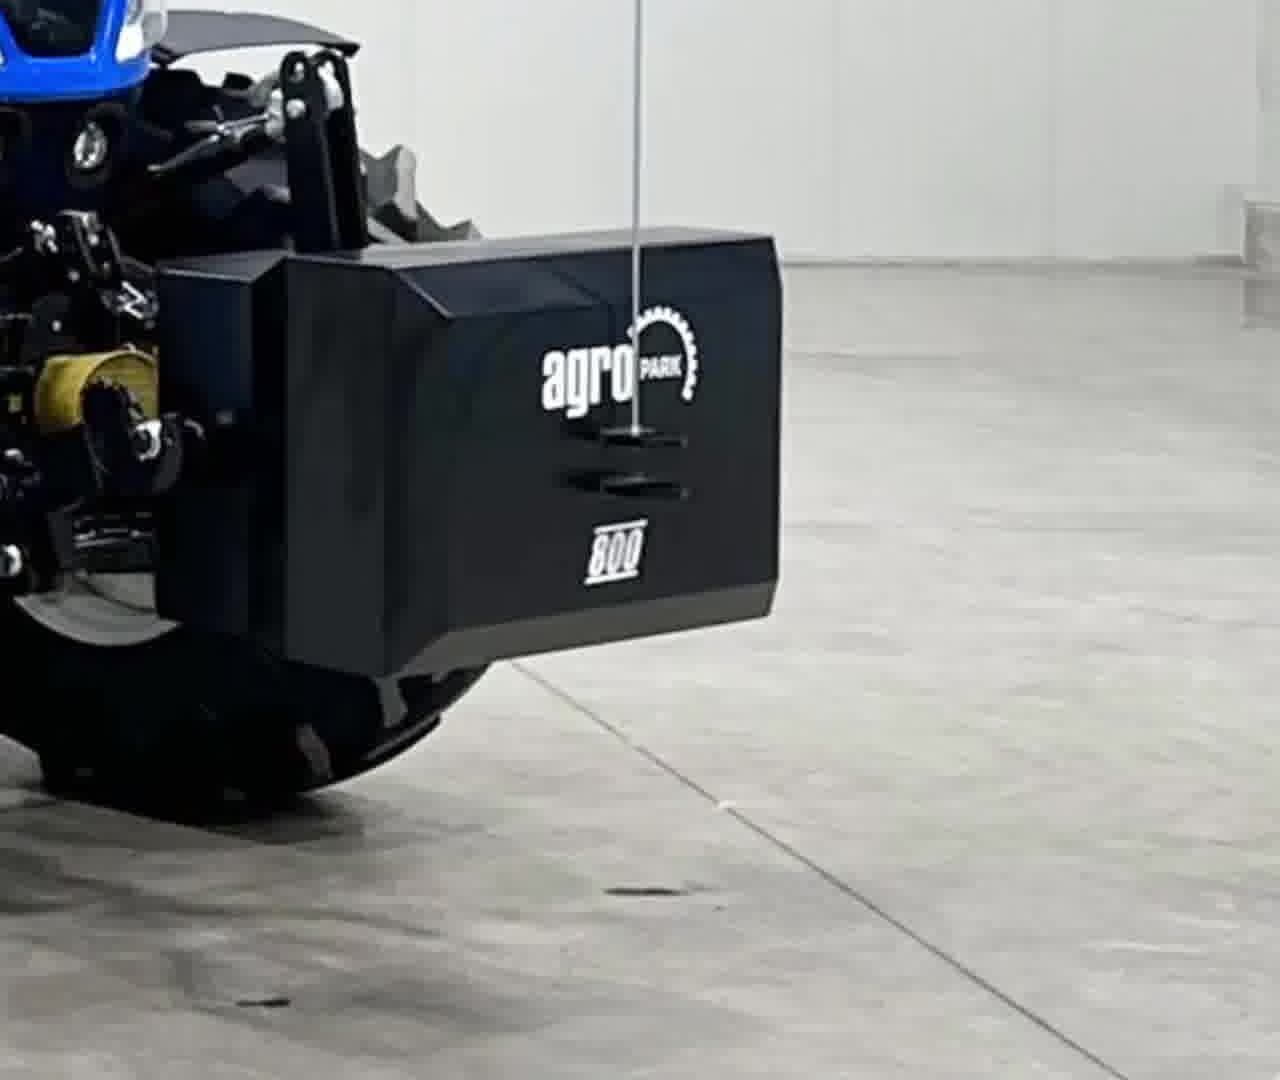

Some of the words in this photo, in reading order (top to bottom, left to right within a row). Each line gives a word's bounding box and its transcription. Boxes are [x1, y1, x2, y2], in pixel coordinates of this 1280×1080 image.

[542, 344, 634, 418] agro
[640, 355, 682, 379] PARK
[588, 527, 646, 577] 800
